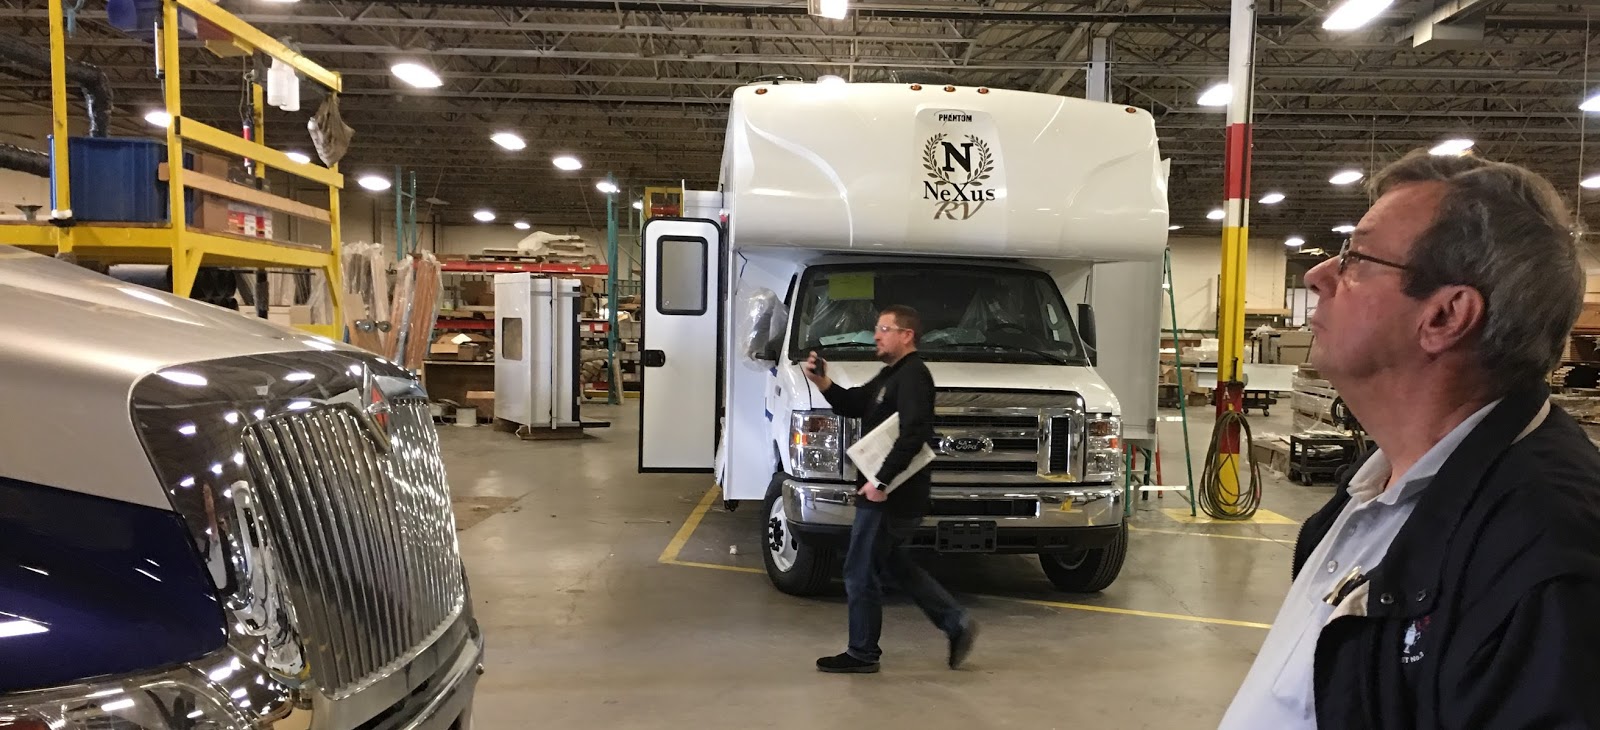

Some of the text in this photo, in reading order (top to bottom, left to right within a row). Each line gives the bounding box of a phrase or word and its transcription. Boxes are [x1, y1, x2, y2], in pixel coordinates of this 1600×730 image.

[938, 114, 973, 122] PHANTOM
[941, 141, 974, 174] N
[923, 180, 996, 202] NeXus
[933, 200, 986, 221] RV
[955, 440, 981, 450] Ford
